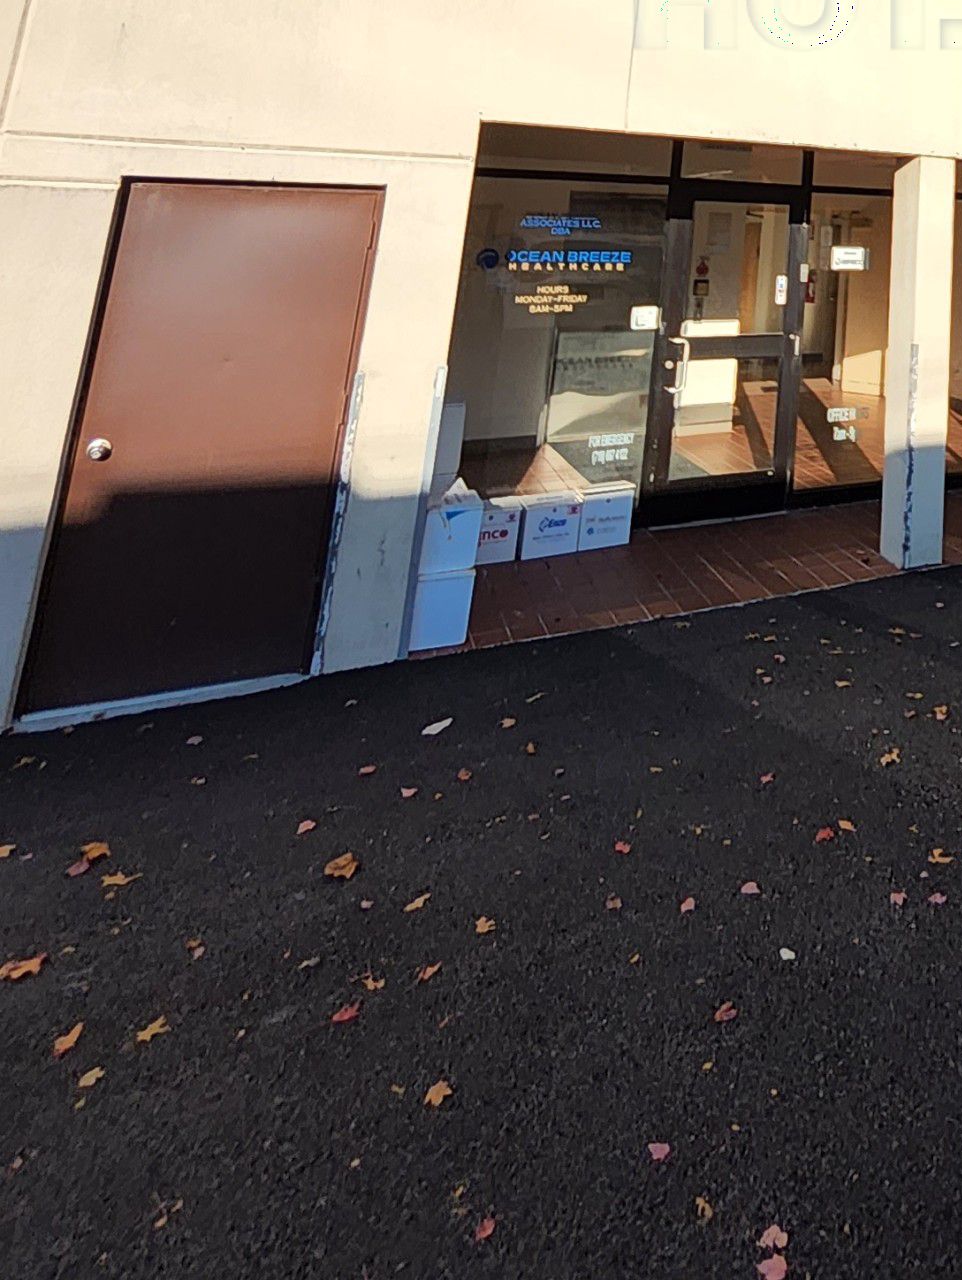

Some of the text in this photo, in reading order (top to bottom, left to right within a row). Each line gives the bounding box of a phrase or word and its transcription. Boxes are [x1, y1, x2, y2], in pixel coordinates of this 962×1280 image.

[520, 218, 580, 228] ASSOCIATES
[508, 250, 632, 264] OCEAN BREEZE
[508, 262, 625, 272] HEALTHCARE
[536, 285, 569, 295] HOURS
